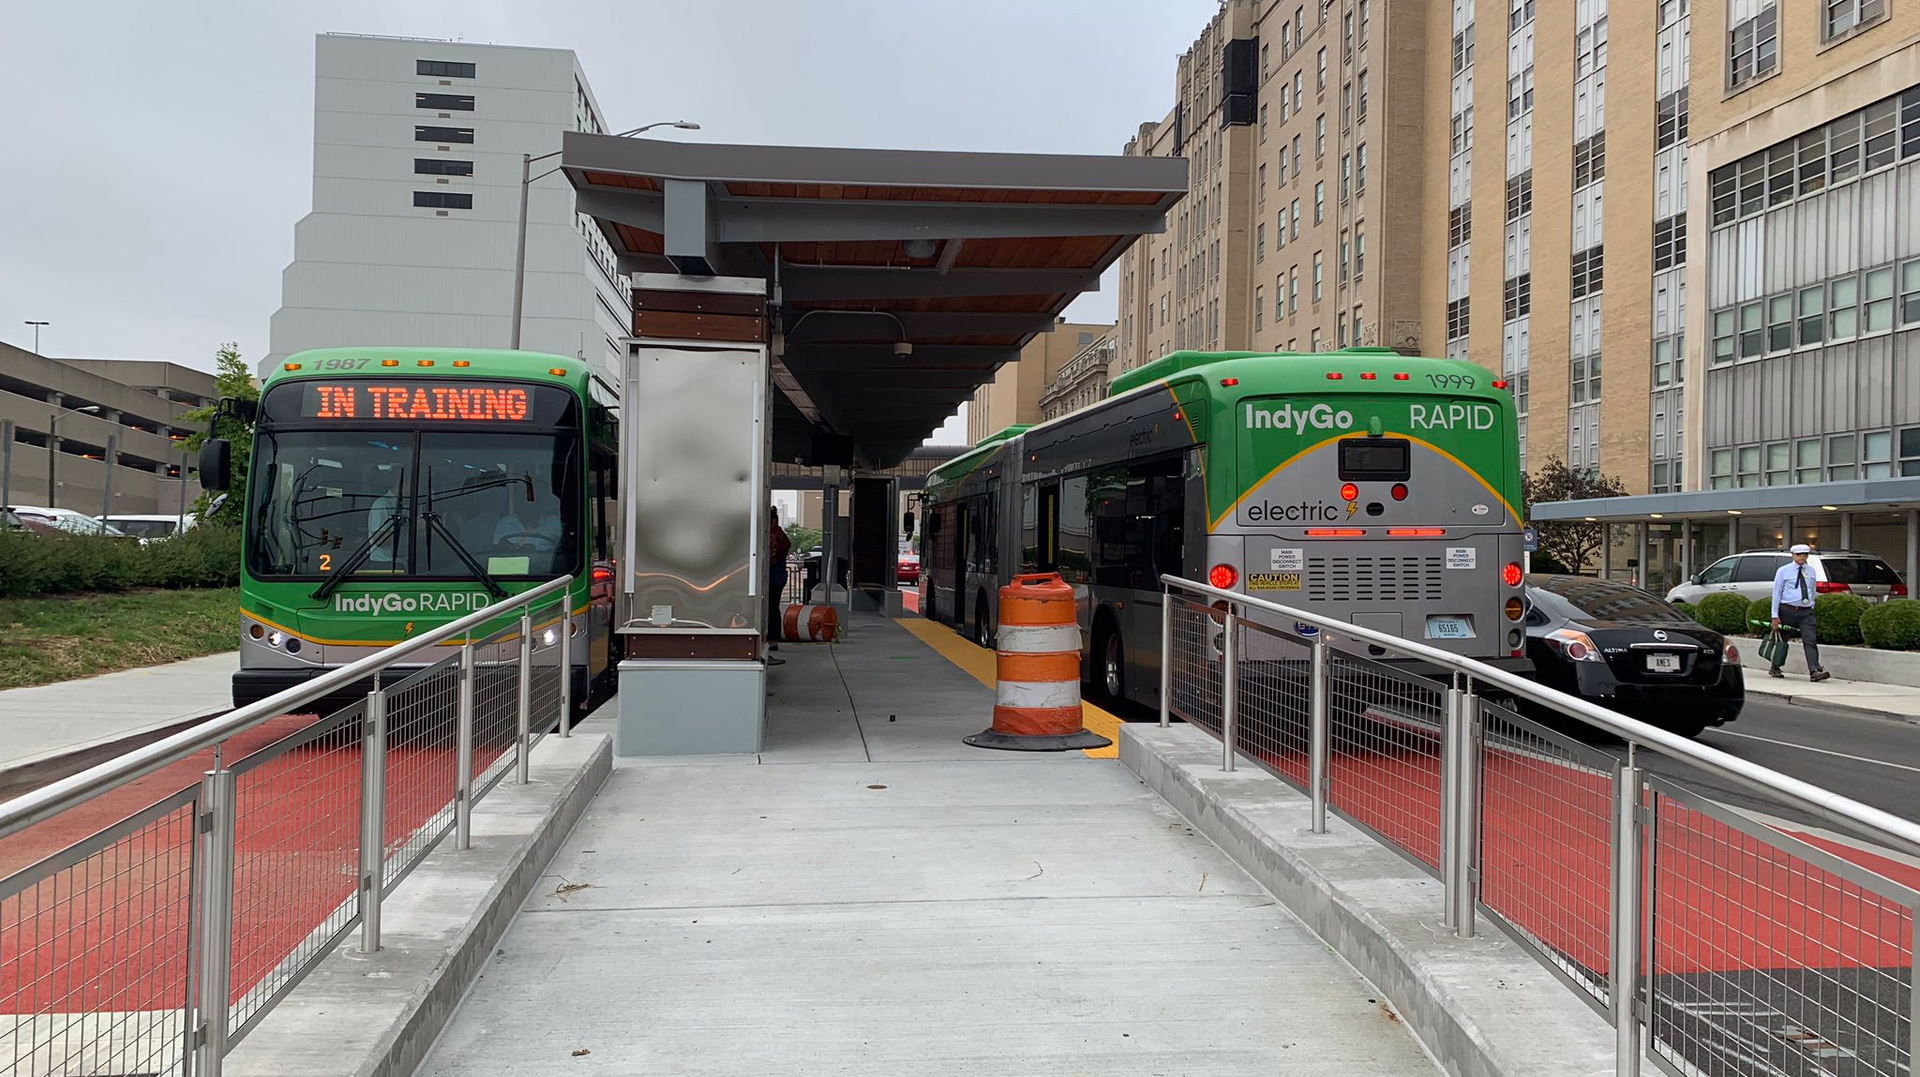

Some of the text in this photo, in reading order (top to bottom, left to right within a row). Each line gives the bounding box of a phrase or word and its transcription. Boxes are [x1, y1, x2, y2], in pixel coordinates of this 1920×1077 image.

[314, 358, 371, 371] 1987
[1425, 374, 1475, 390] 1999
[317, 387, 527, 420] IN TRAINING
[1246, 404, 1494, 435] IndyGo RAPID
[1130, 426, 1154, 447] electric
[1248, 500, 1339, 521] electric
[319, 554, 331, 570] 2
[335, 593, 489, 616] IndyGo RAPID
[1438, 624, 1459, 633] 65165
